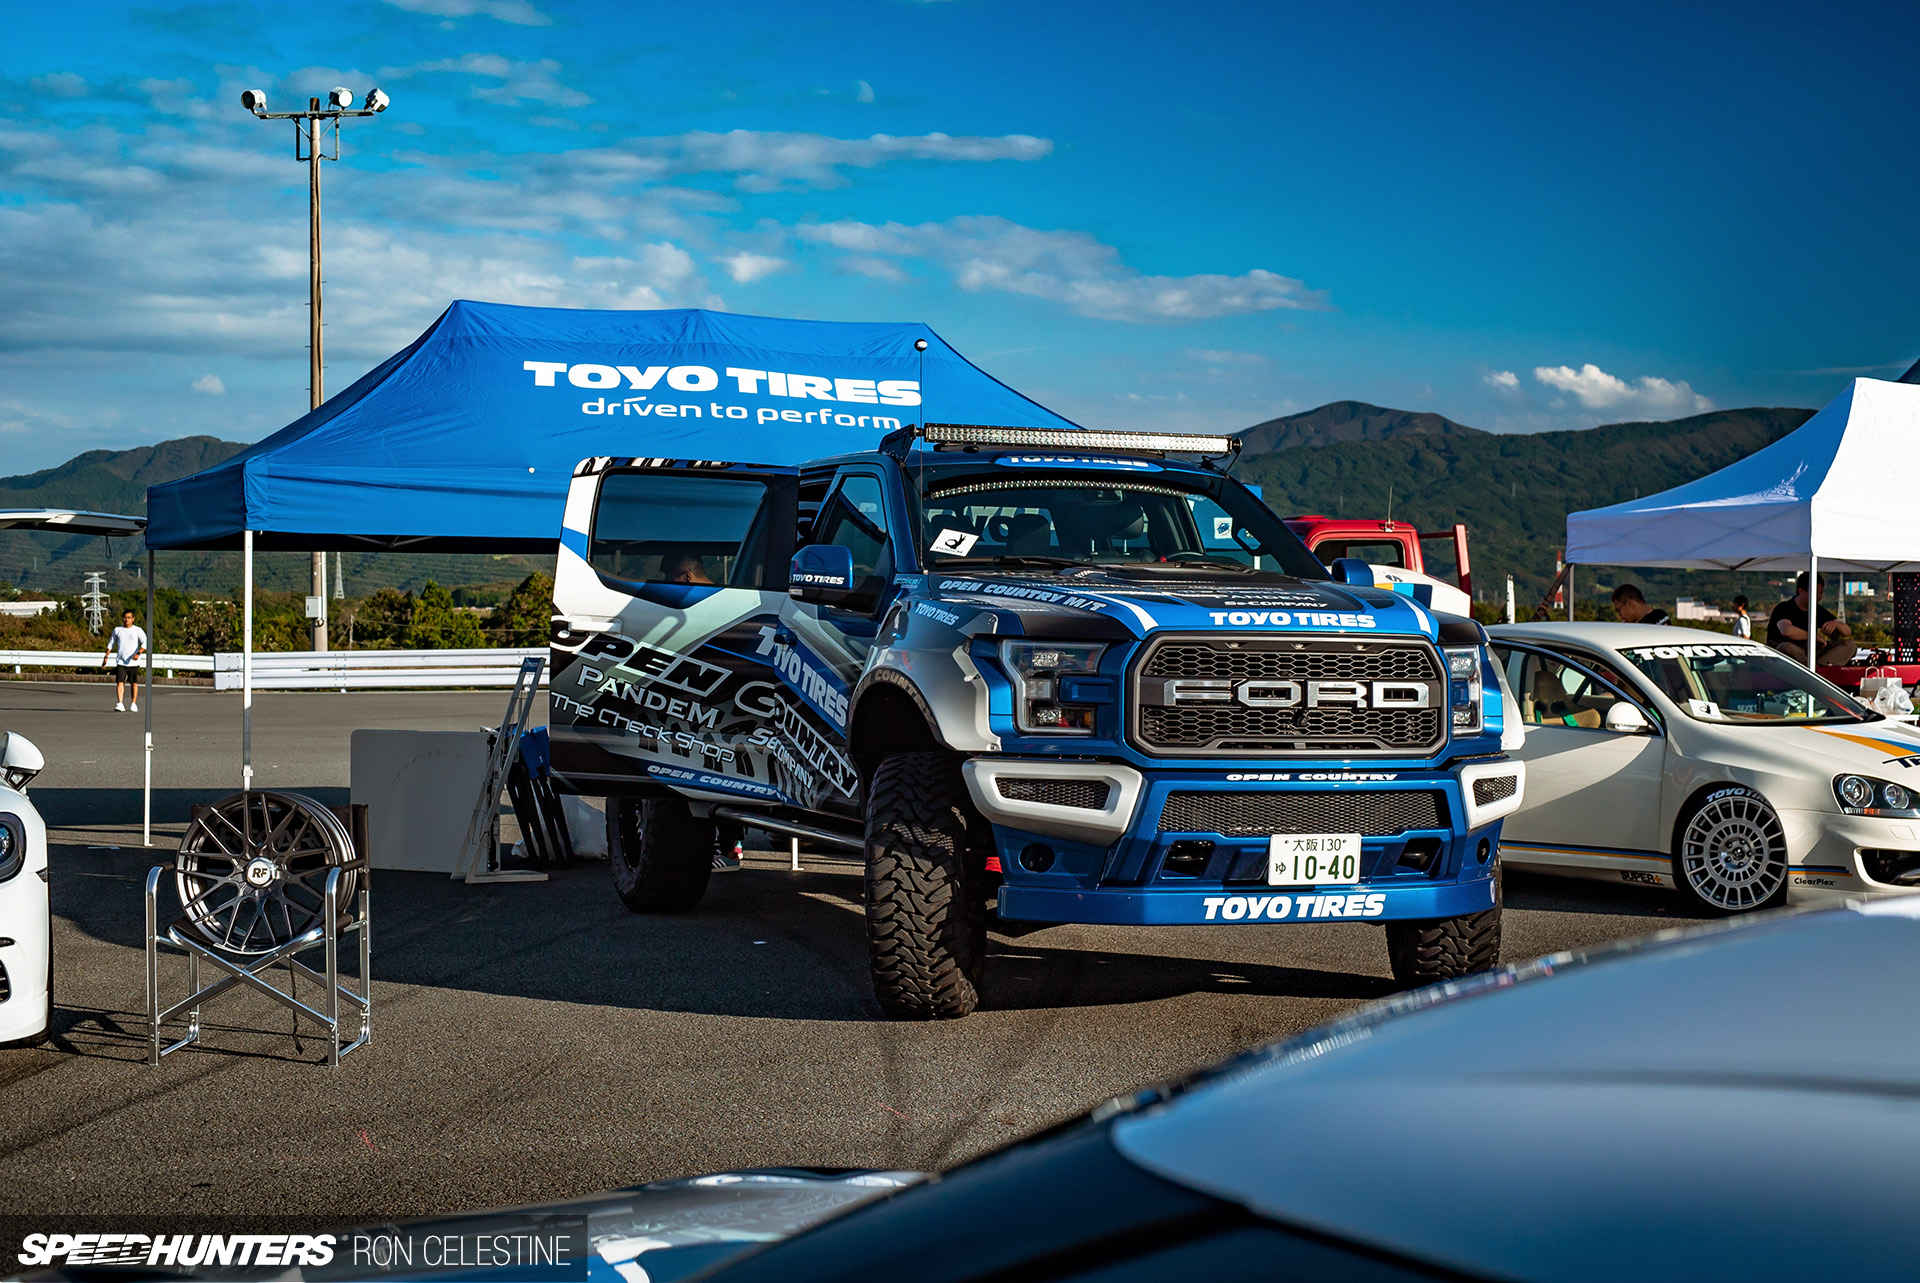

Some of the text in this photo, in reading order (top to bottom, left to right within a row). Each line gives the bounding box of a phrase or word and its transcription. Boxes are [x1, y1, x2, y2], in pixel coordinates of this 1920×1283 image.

[523, 360, 922, 406] TOYO TIRES
[582, 396, 901, 429] driven to perform
[792, 573, 845, 585] TOYO TIRES
[938, 580, 1107, 612] OPEN COUNTRY M/T
[915, 602, 960, 627] TOYO TIRES
[1209, 611, 1377, 628] TOYO TIRES
[1633, 645, 1716, 661] TOYO
[576, 663, 719, 729] PANDEM
[801, 662, 849, 728] TIRES
[874, 668, 937, 726] COUNTRY
[1164, 679, 1431, 708] FORD
[551, 692, 735, 763] The Check Shop
[647, 765, 778, 796] OPEN COUNTRY
[1226, 773, 1398, 781] OPEN COUNTRY
[1706, 787, 1746, 803] TOYO
[1292, 838, 1342, 852] 大阪 130
[252, 867, 268, 878] RF
[1275, 861, 1287, 875] ゆ
[1293, 854, 1355, 881] 10-40
[1794, 877, 1835, 886] ClearPlex
[1203, 893, 1386, 921] TOYO TIRES
